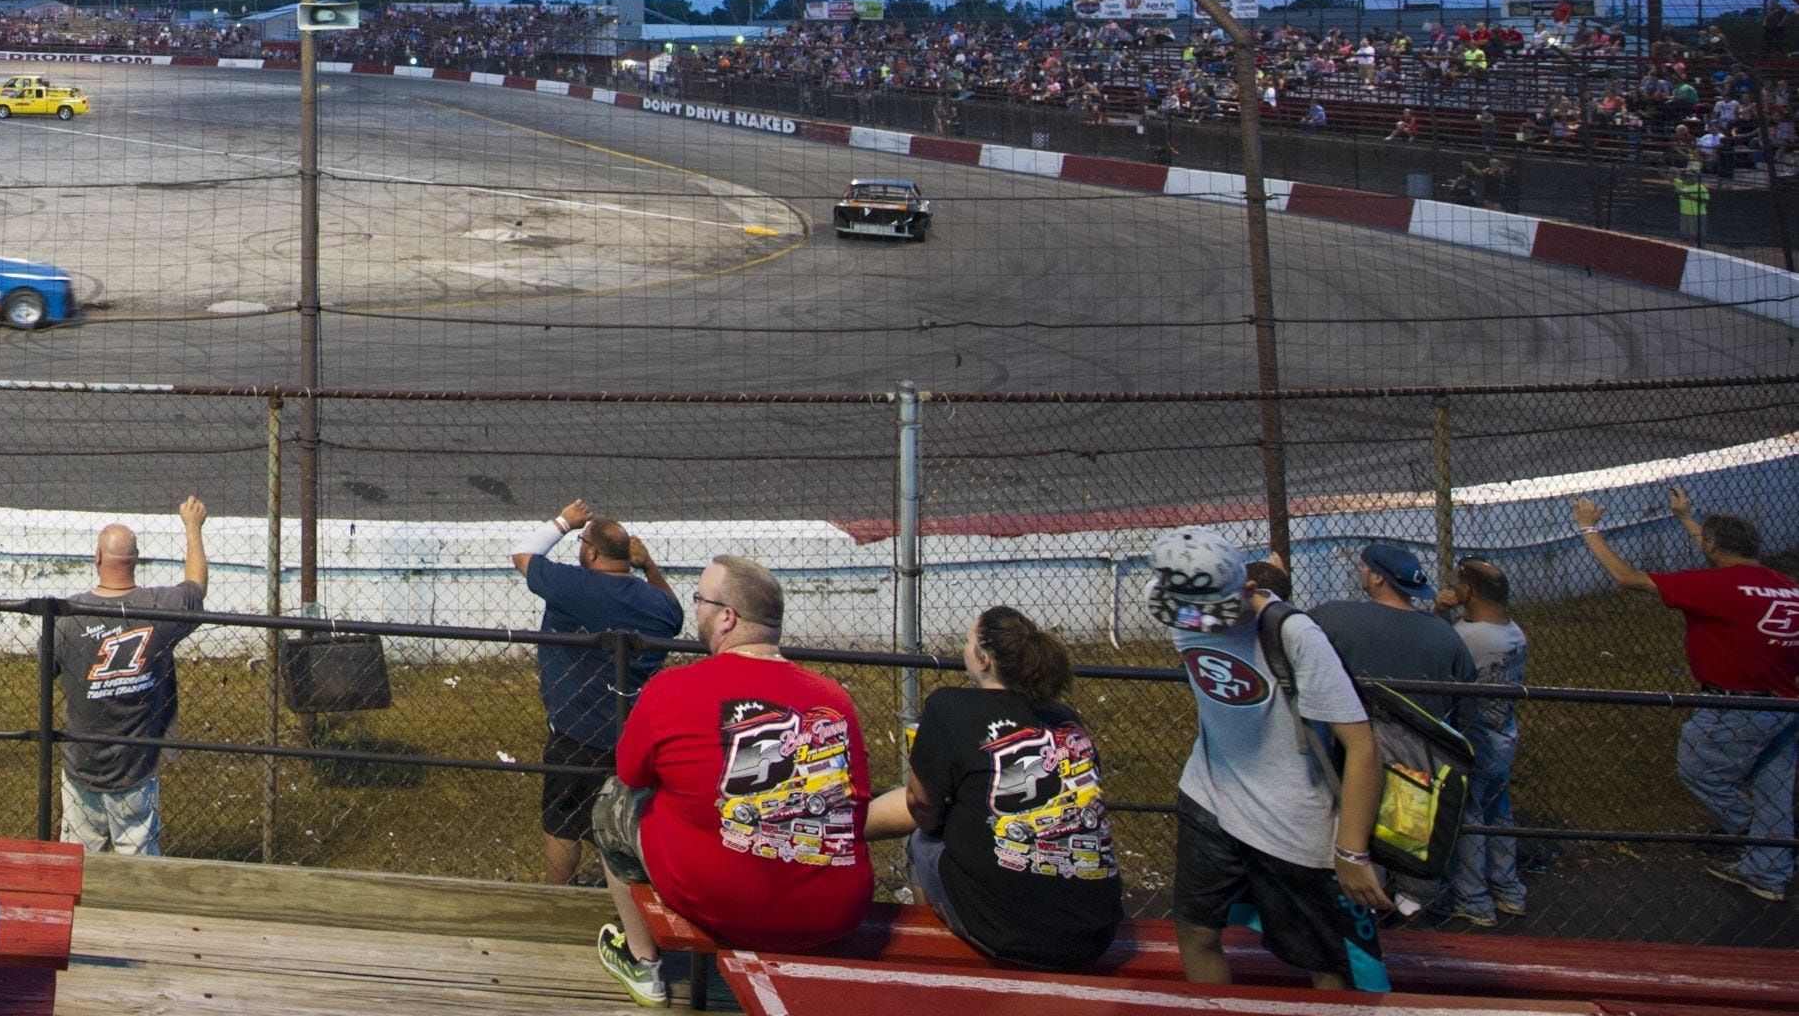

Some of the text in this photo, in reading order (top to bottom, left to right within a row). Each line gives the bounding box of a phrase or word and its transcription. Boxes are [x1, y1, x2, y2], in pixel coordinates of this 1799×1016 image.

[642, 97, 796, 134] DON'T DRIVE NAKED
[87, 626, 155, 680] 1
[1197, 655, 1251, 699] SF
